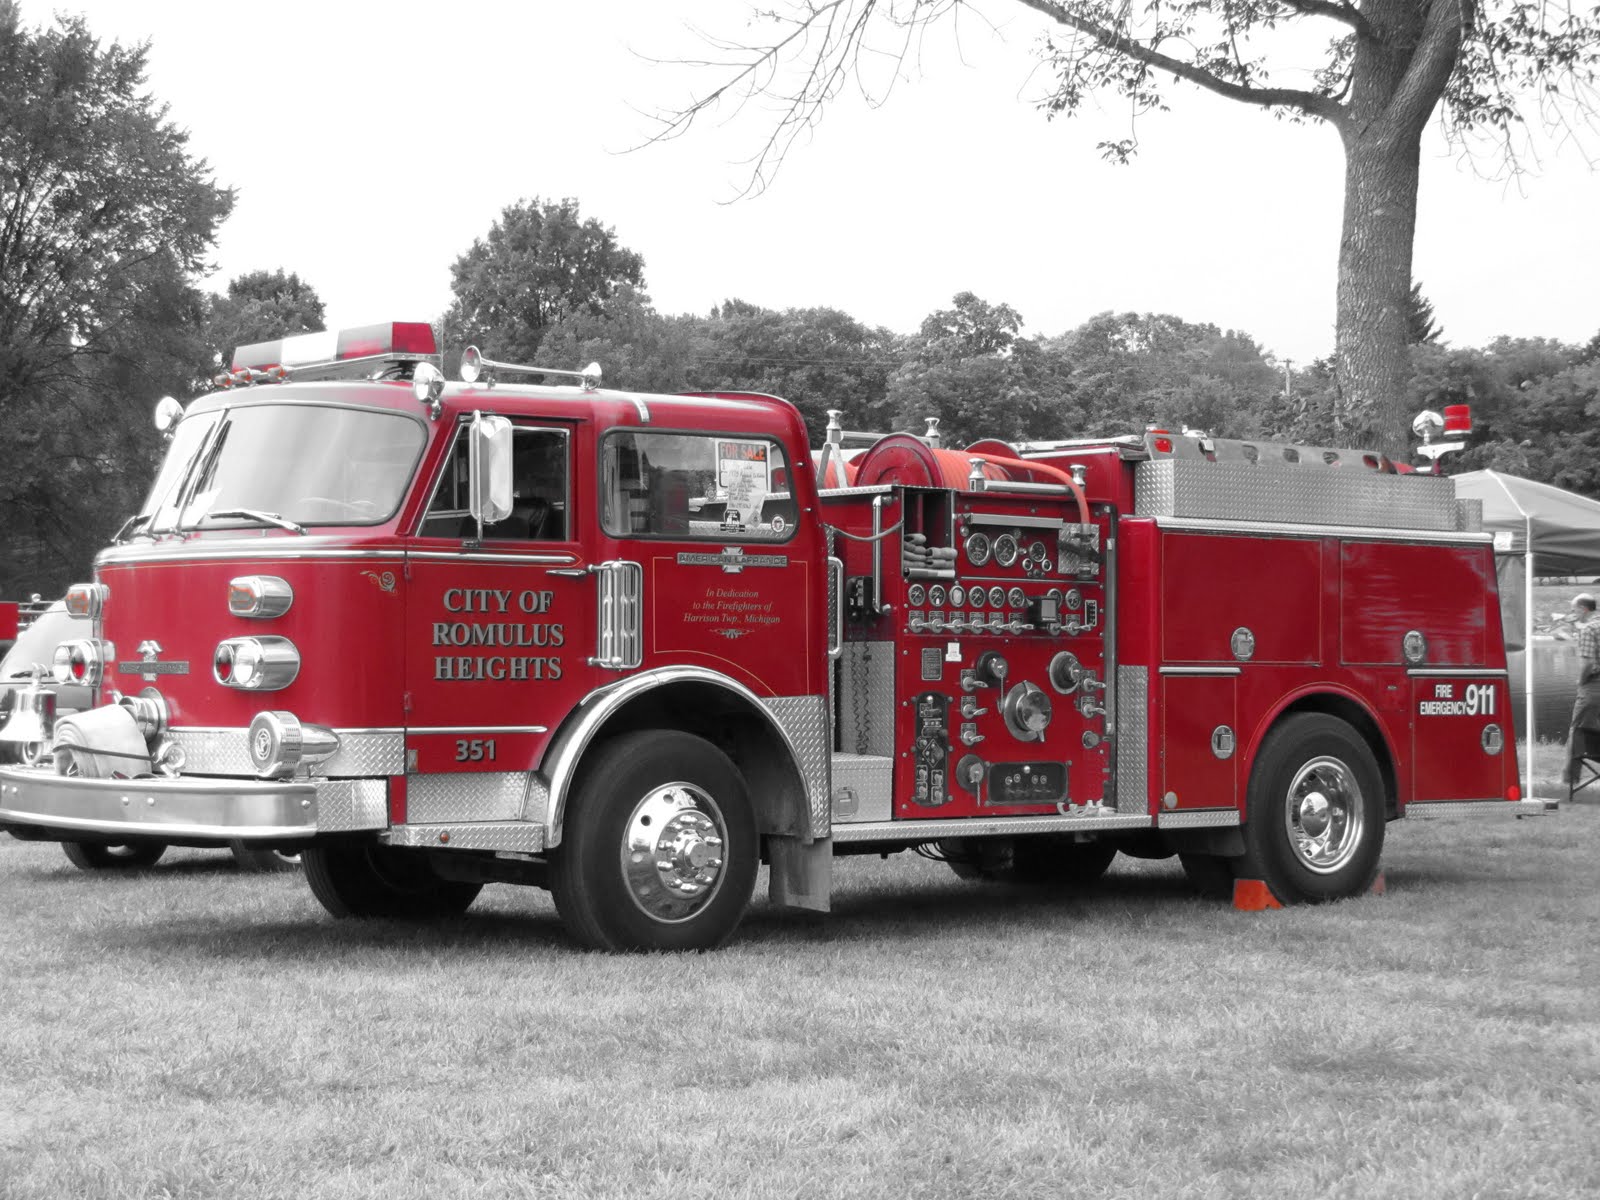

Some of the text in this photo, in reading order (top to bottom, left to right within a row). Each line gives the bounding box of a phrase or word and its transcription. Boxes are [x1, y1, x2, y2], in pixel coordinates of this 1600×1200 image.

[720, 443, 765, 461] FOR SALE
[680, 554, 732, 564] AMERICAN
[443, 588, 554, 613] CITY OF
[706, 588, 758, 598] In Dedication
[693, 601, 772, 612] to the Firefighters of
[684, 613, 719, 623] Harrison
[744, 614, 781, 625] Michigan
[432, 622, 565, 647] ROMULUS
[434, 656, 563, 681] HEIGHTS
[1435, 684, 1453, 698] FIRE
[1420, 701, 1467, 715] EMERGENCY
[1465, 684, 1495, 716] 911
[456, 739, 496, 761] 351
